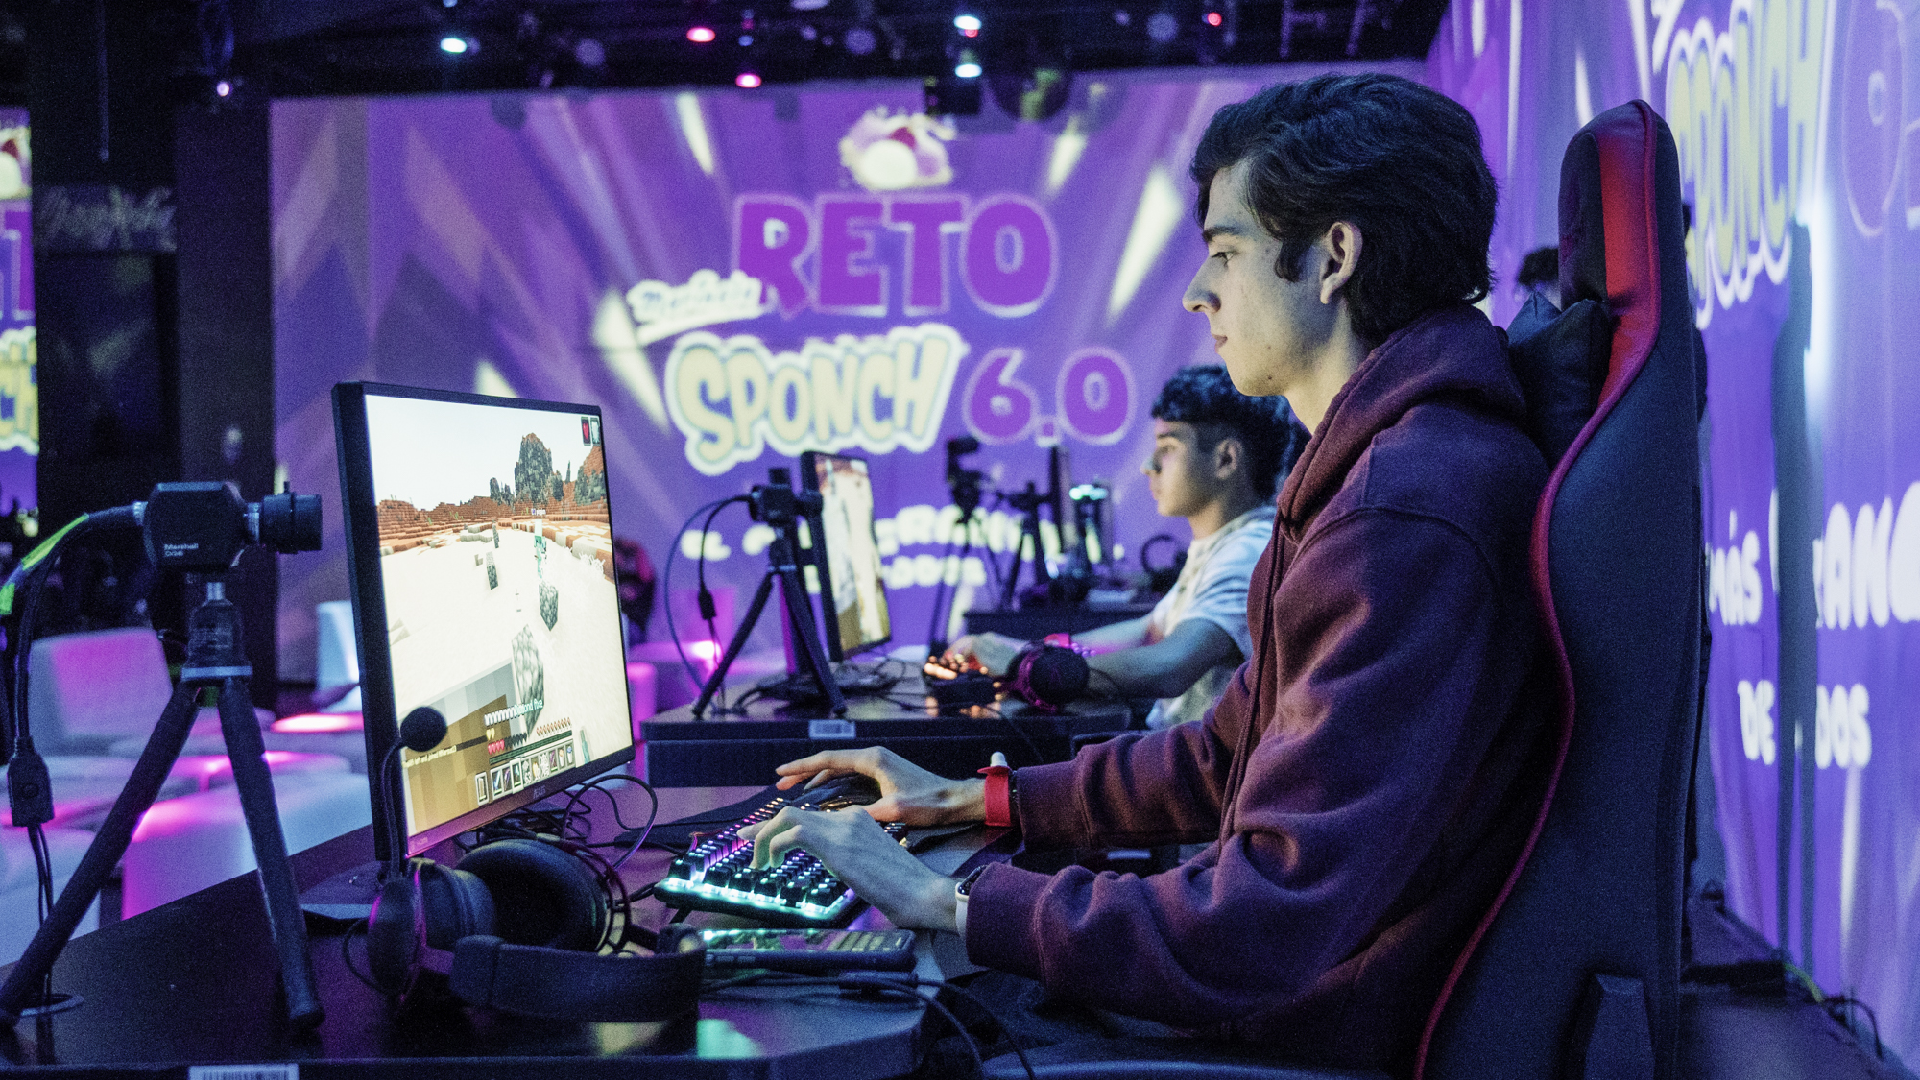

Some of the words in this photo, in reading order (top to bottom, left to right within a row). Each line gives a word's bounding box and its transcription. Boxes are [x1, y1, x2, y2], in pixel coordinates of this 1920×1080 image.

[732, 191, 1059, 319] RETO
[664, 323, 970, 476] SPONCH
[961, 347, 1138, 446] 6.0
